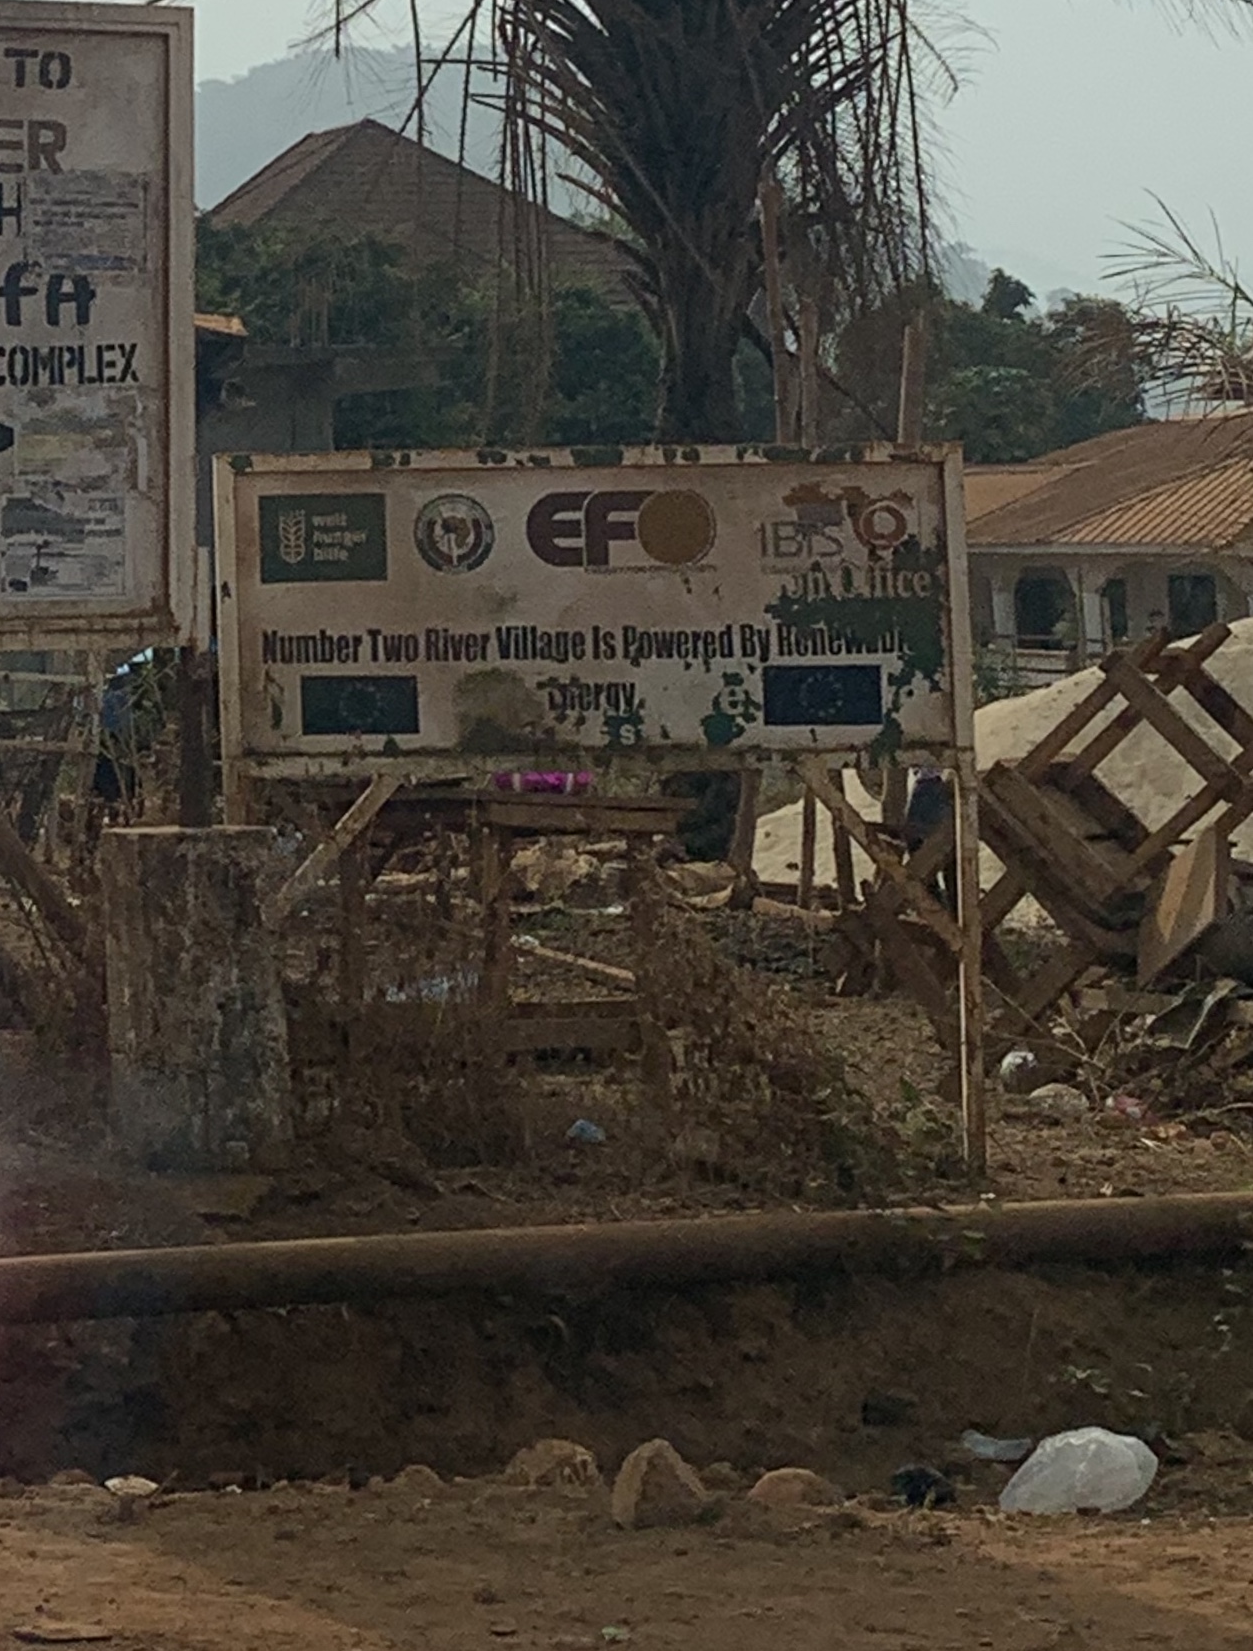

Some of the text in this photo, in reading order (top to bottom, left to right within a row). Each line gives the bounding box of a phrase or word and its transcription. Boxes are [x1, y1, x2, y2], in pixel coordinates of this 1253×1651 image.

[4, 47, 73, 90] TO
[262, 629, 363, 664] Number
[366, 628, 420, 663] Two
[424, 627, 491, 663] River
[495, 624, 587, 664] Village
[591, 625, 616, 661] Is
[621, 623, 735, 661] Powered
[740, 623, 771, 664] By
